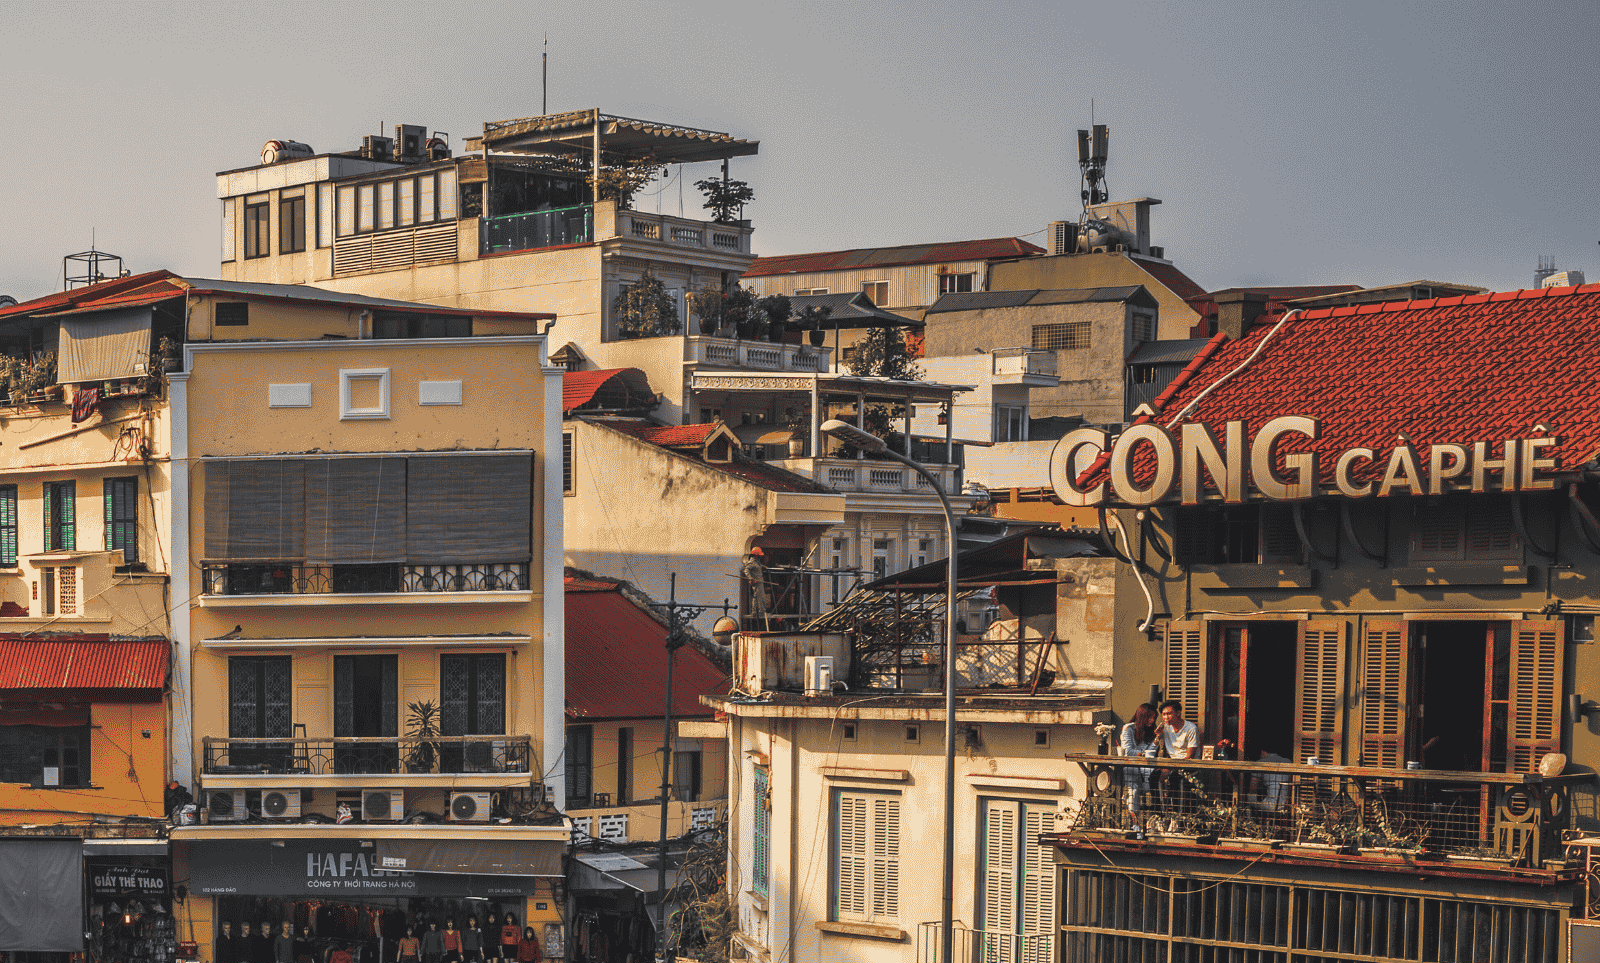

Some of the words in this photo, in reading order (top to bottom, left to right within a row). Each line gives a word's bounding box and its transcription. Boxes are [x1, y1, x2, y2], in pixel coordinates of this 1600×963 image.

[138, 877, 164, 889] THAO
[307, 880, 331, 889] CÔNG
[333, 881, 341, 889] TY
[362, 881, 387, 889] TRANG
